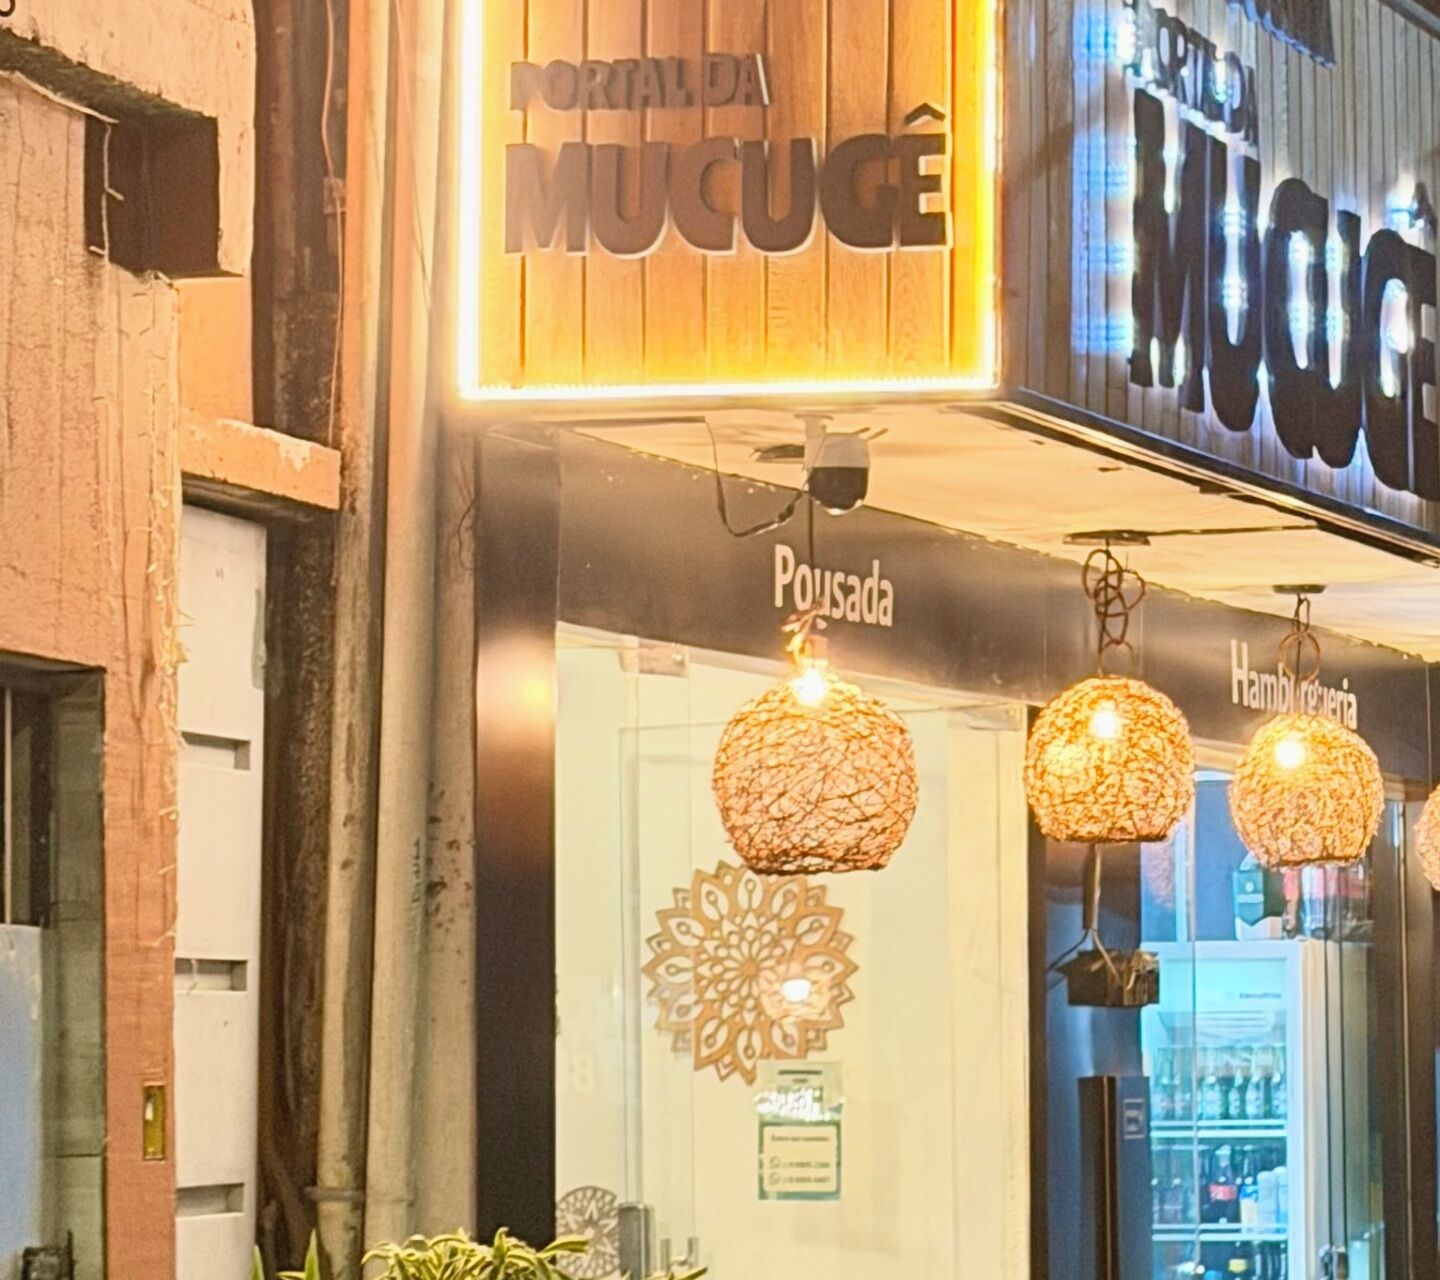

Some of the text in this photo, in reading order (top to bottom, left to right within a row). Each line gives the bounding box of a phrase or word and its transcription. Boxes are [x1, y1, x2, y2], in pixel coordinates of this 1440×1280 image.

[510, 53, 771, 111] PORTAL DA
[504, 102, 953, 256] MUCUGÊ
[775, 544, 894, 628] Pousada
